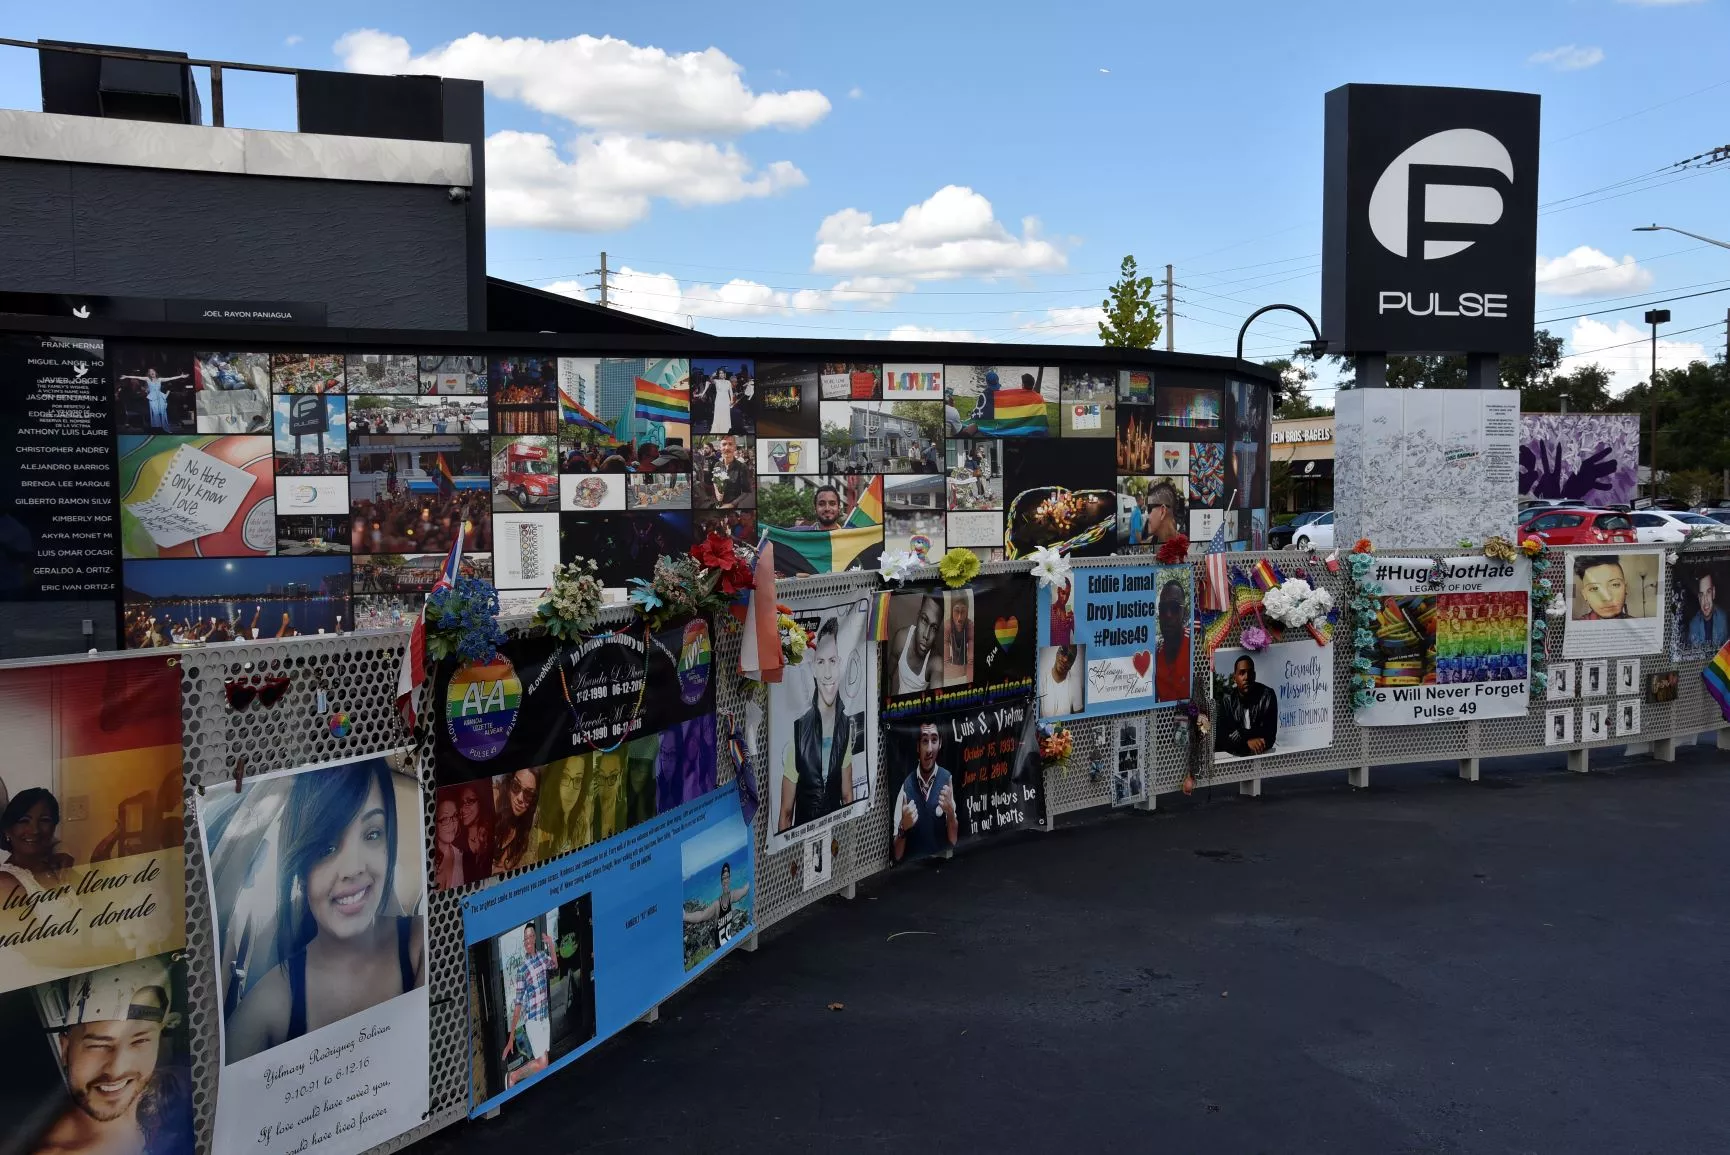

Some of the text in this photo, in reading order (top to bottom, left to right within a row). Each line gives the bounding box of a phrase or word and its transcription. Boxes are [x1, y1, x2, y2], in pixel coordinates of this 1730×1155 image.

[1379, 291, 1507, 317] PULSE
[888, 372, 941, 390] LOVE
[1304, 428, 1330, 441] BAGELS
[184, 460, 226, 488] No Hate
[172, 474, 228, 504] Only know
[1088, 572, 1154, 594] Eddie Jamal
[1410, 584, 1446, 592] LEGACY
[1086, 600, 1156, 622] Droy Justice
[1094, 625, 1148, 648] #Pulse49
[570, 650, 580, 667] In
[1285, 656, 1320, 680] Eternally
[1280, 678, 1328, 702] Missing You
[1393, 690, 1421, 702] Will
[1426, 687, 1470, 700] Never
[1475, 682, 1525, 698] Forget
[1280, 708, 1328, 728] SHANE TOMLINSON
[1414, 702, 1477, 718] Pulse 49
[952, 708, 1024, 742] Luis S. Vielma
[966, 784, 1036, 818] You'll always be
[970, 808, 1024, 834] in our hearts
[2, 858, 160, 921] lugar lleno de
[90, 894, 156, 928] donde
[264, 1025, 392, 1090] Yilmary Rodriguez Solivan
[324, 1076, 332, 1086] to
[258, 1126, 272, 1146] If
[276, 1122, 294, 1136] love
[298, 1106, 320, 1126] could
[324, 1100, 343, 1112] have
[346, 1084, 370, 1102] saved
[286, 1108, 388, 1155] ould have lived forever
